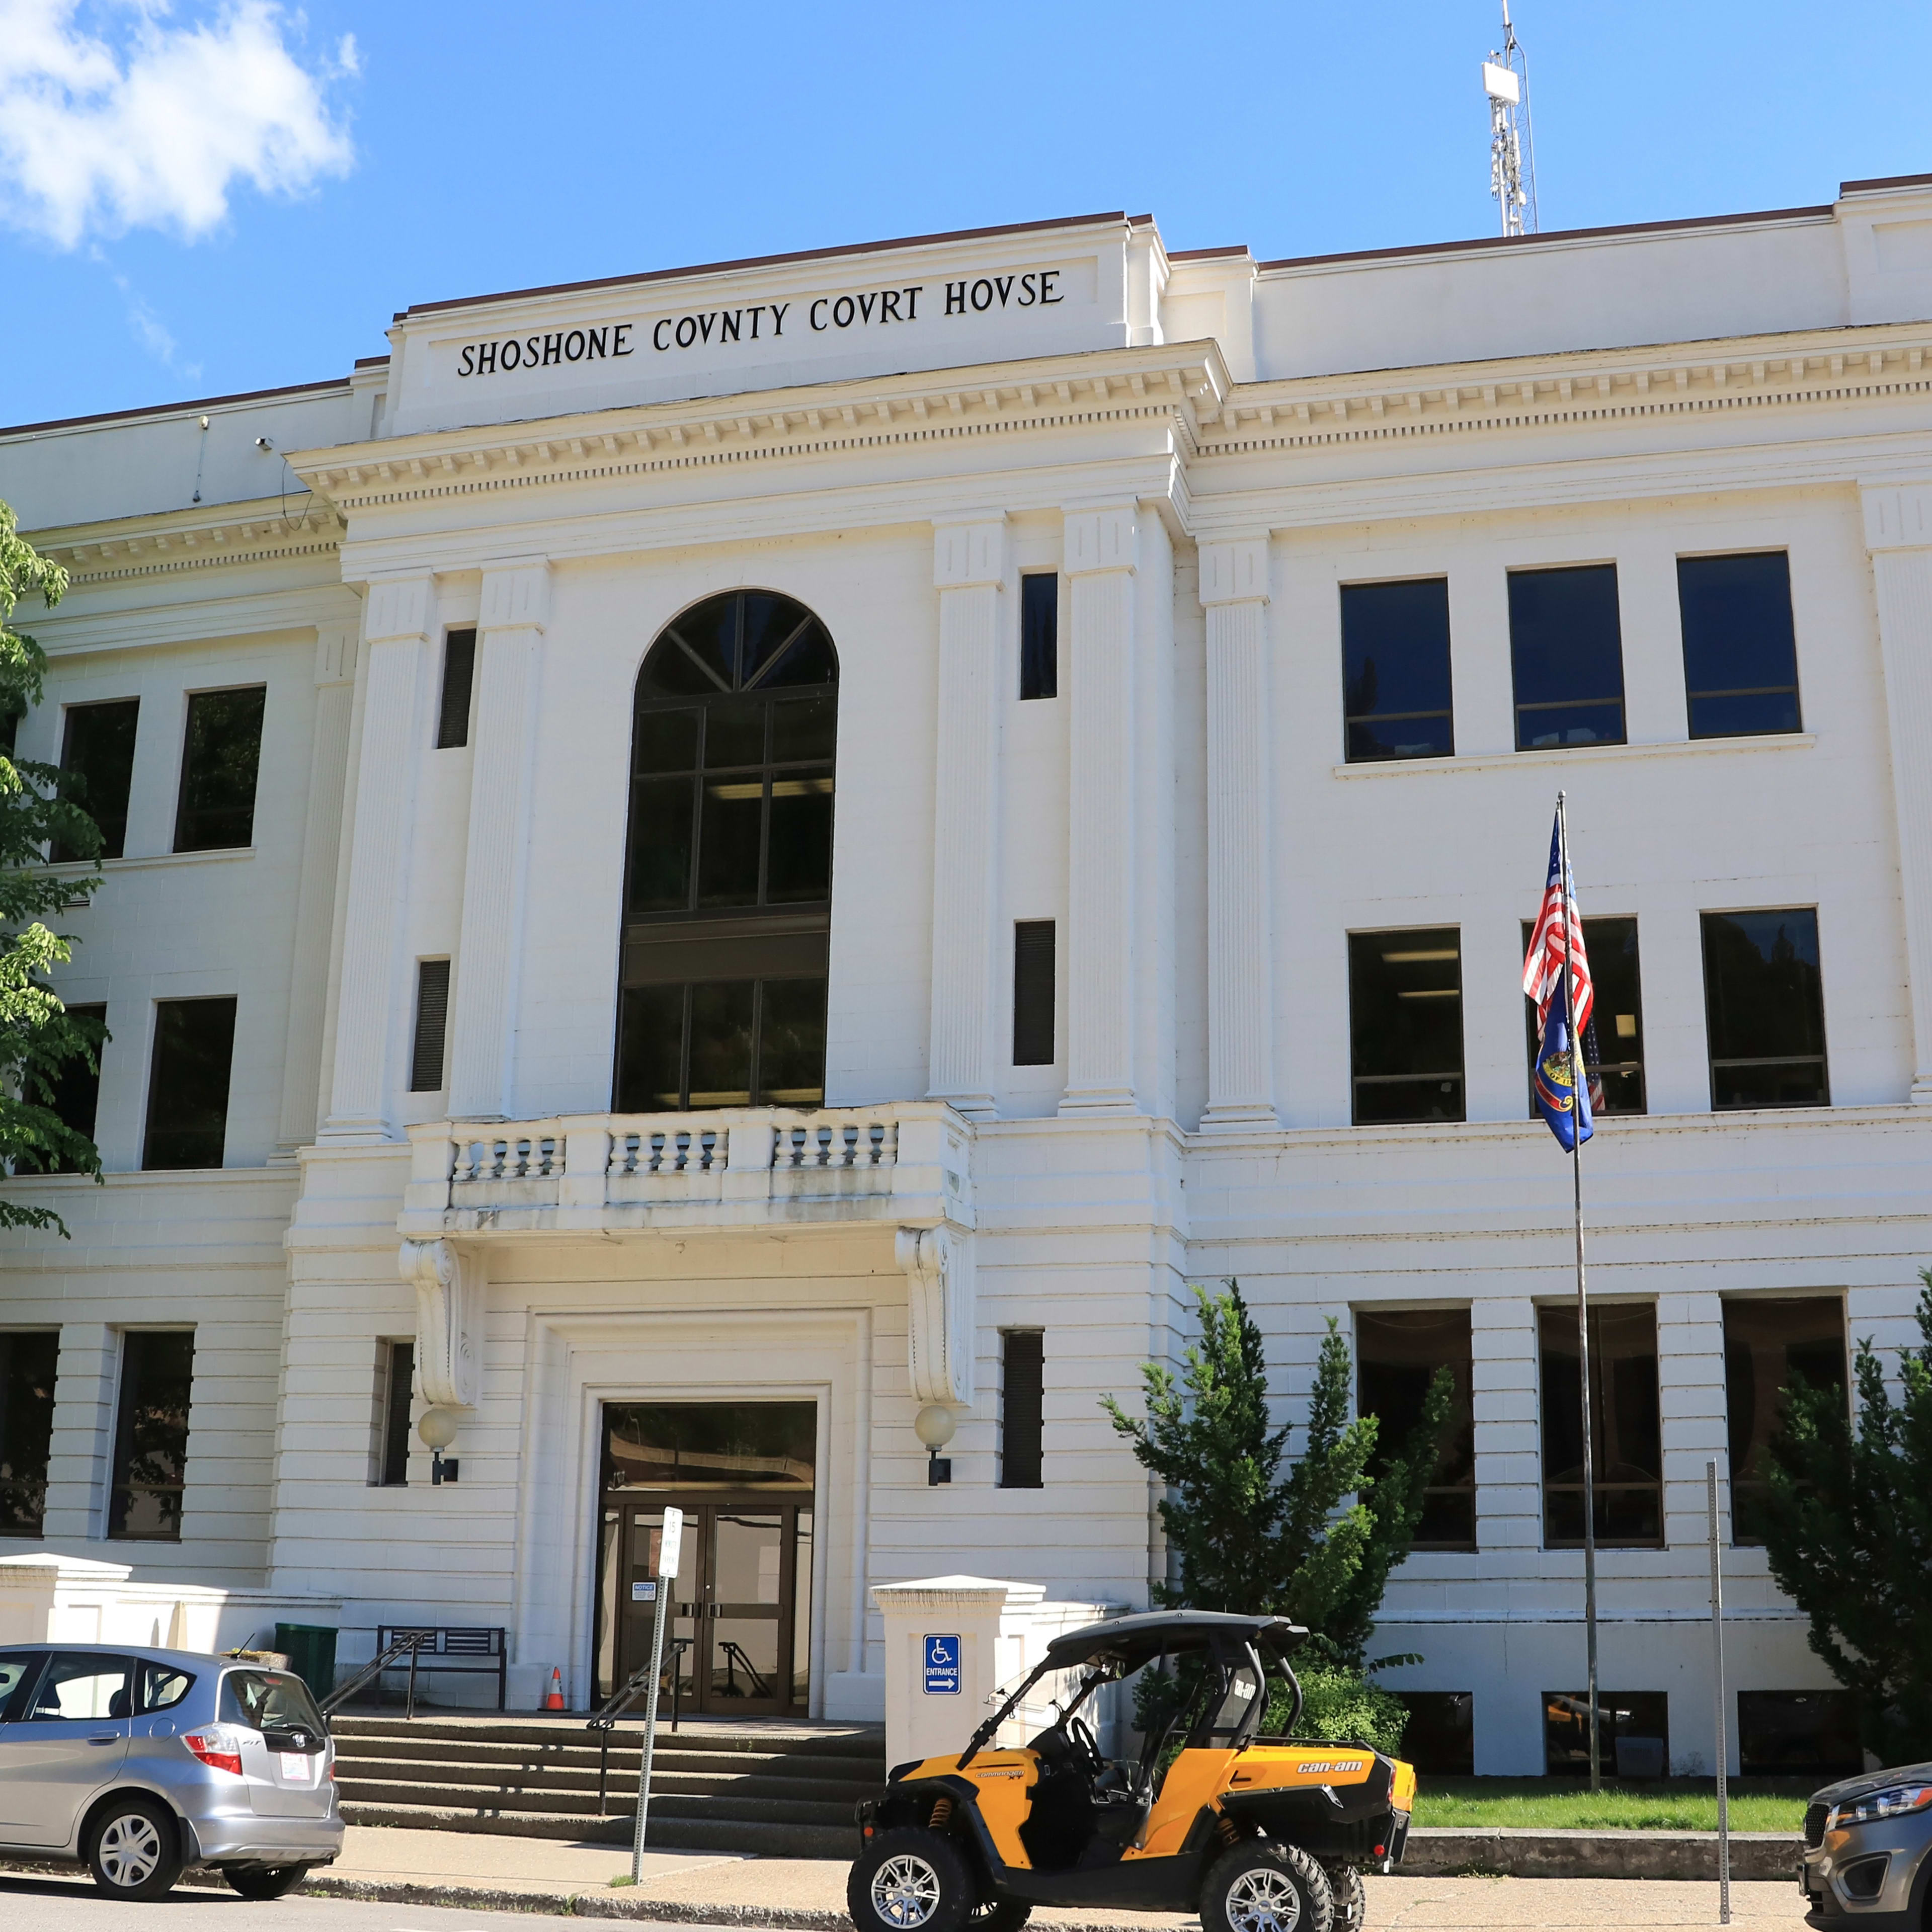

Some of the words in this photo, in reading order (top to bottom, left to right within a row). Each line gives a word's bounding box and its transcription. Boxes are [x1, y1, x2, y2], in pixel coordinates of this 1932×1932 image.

[457, 324, 634, 377] SHOSHONE
[653, 303, 790, 351] COVNTY
[810, 286, 923, 331] COVRT
[944, 271, 1065, 315] HOVSE
[669, 1521, 676, 1534] 15
[926, 1668, 957, 1676] ENTRANCE
[1297, 1761, 1363, 1774] can-am
